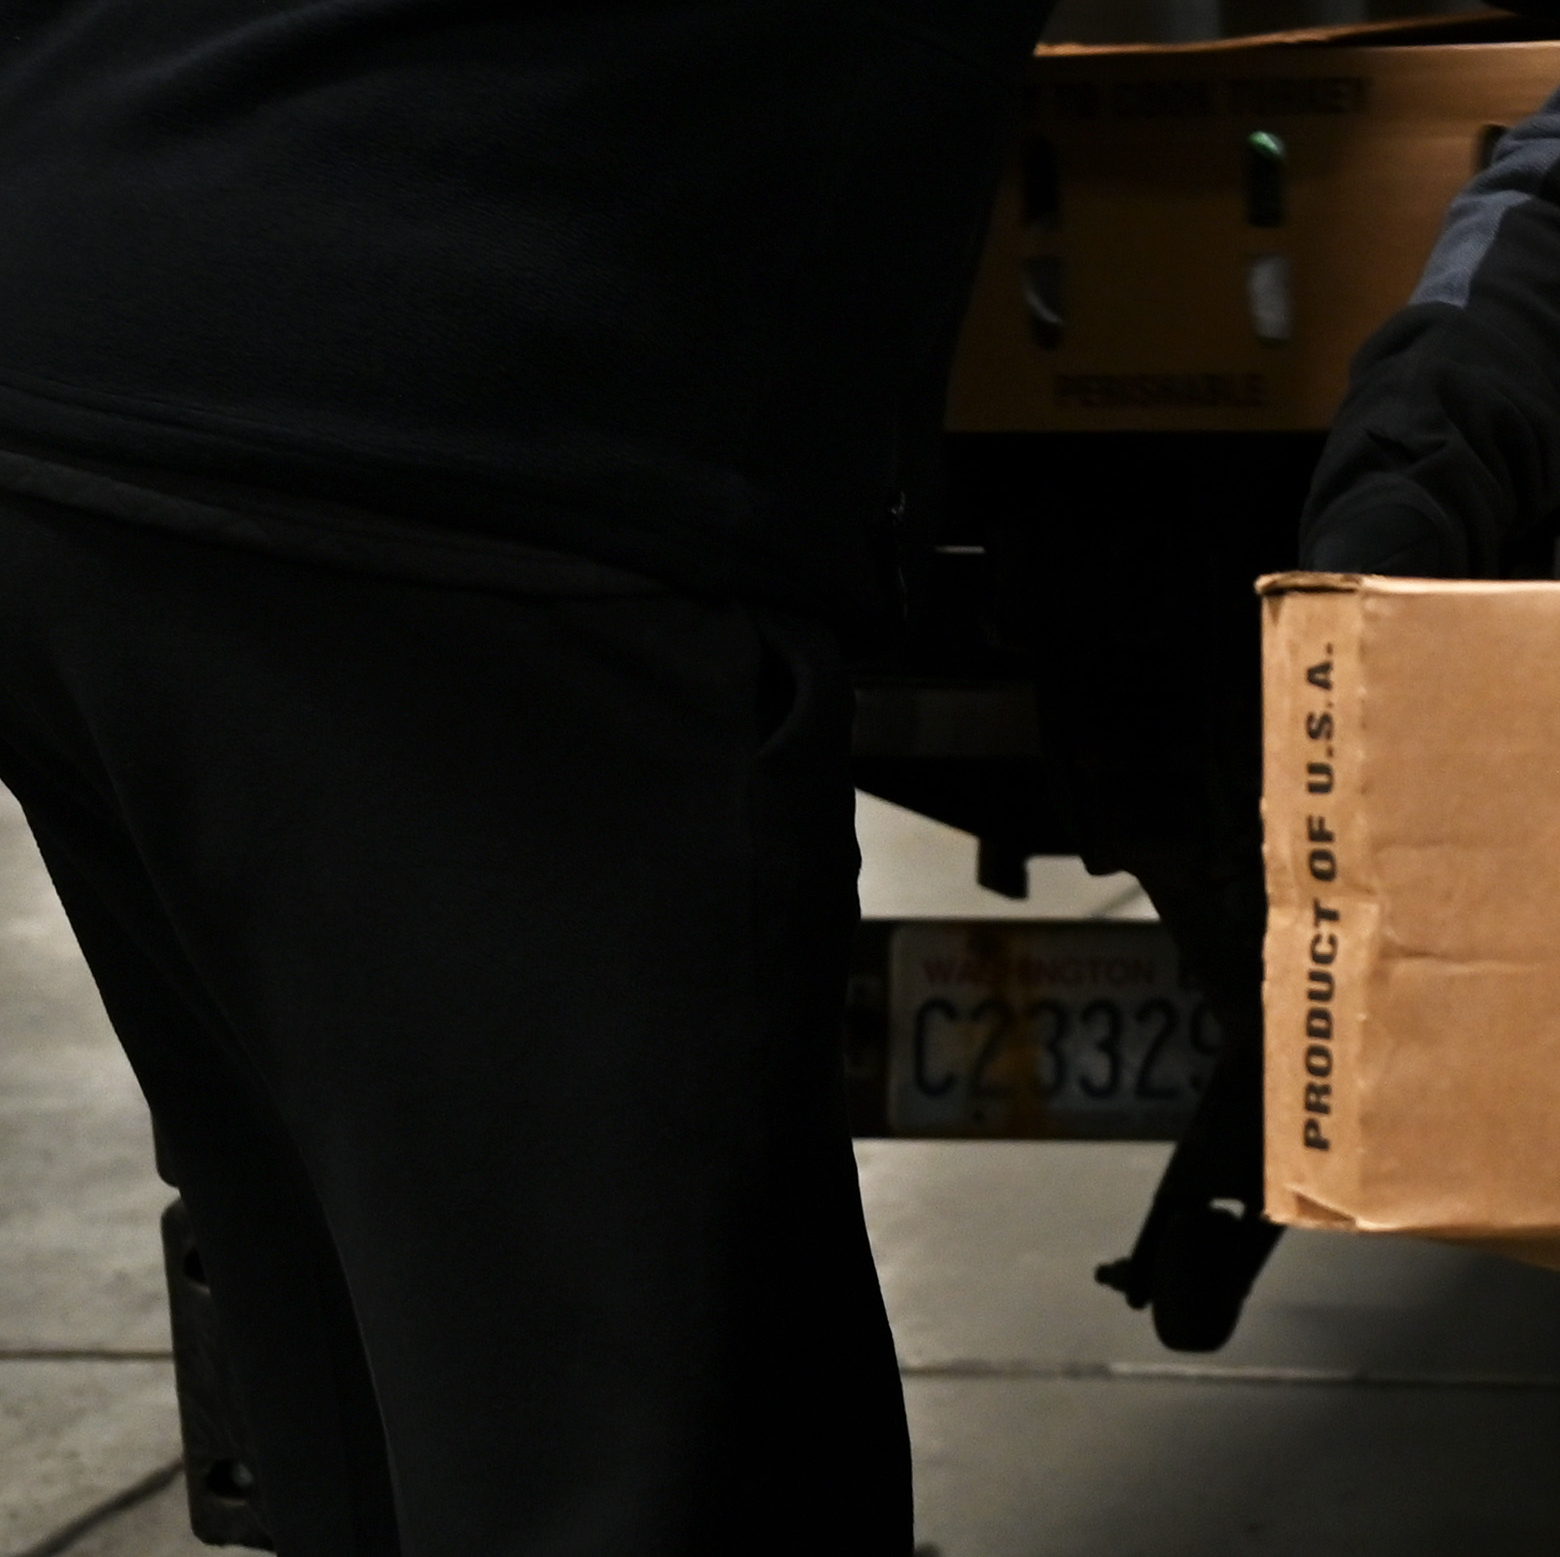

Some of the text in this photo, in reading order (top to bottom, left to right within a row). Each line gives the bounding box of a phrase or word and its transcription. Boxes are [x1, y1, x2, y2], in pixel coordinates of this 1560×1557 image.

[1303, 642, 1341, 1152] PRODUCT OF U.S.A.
